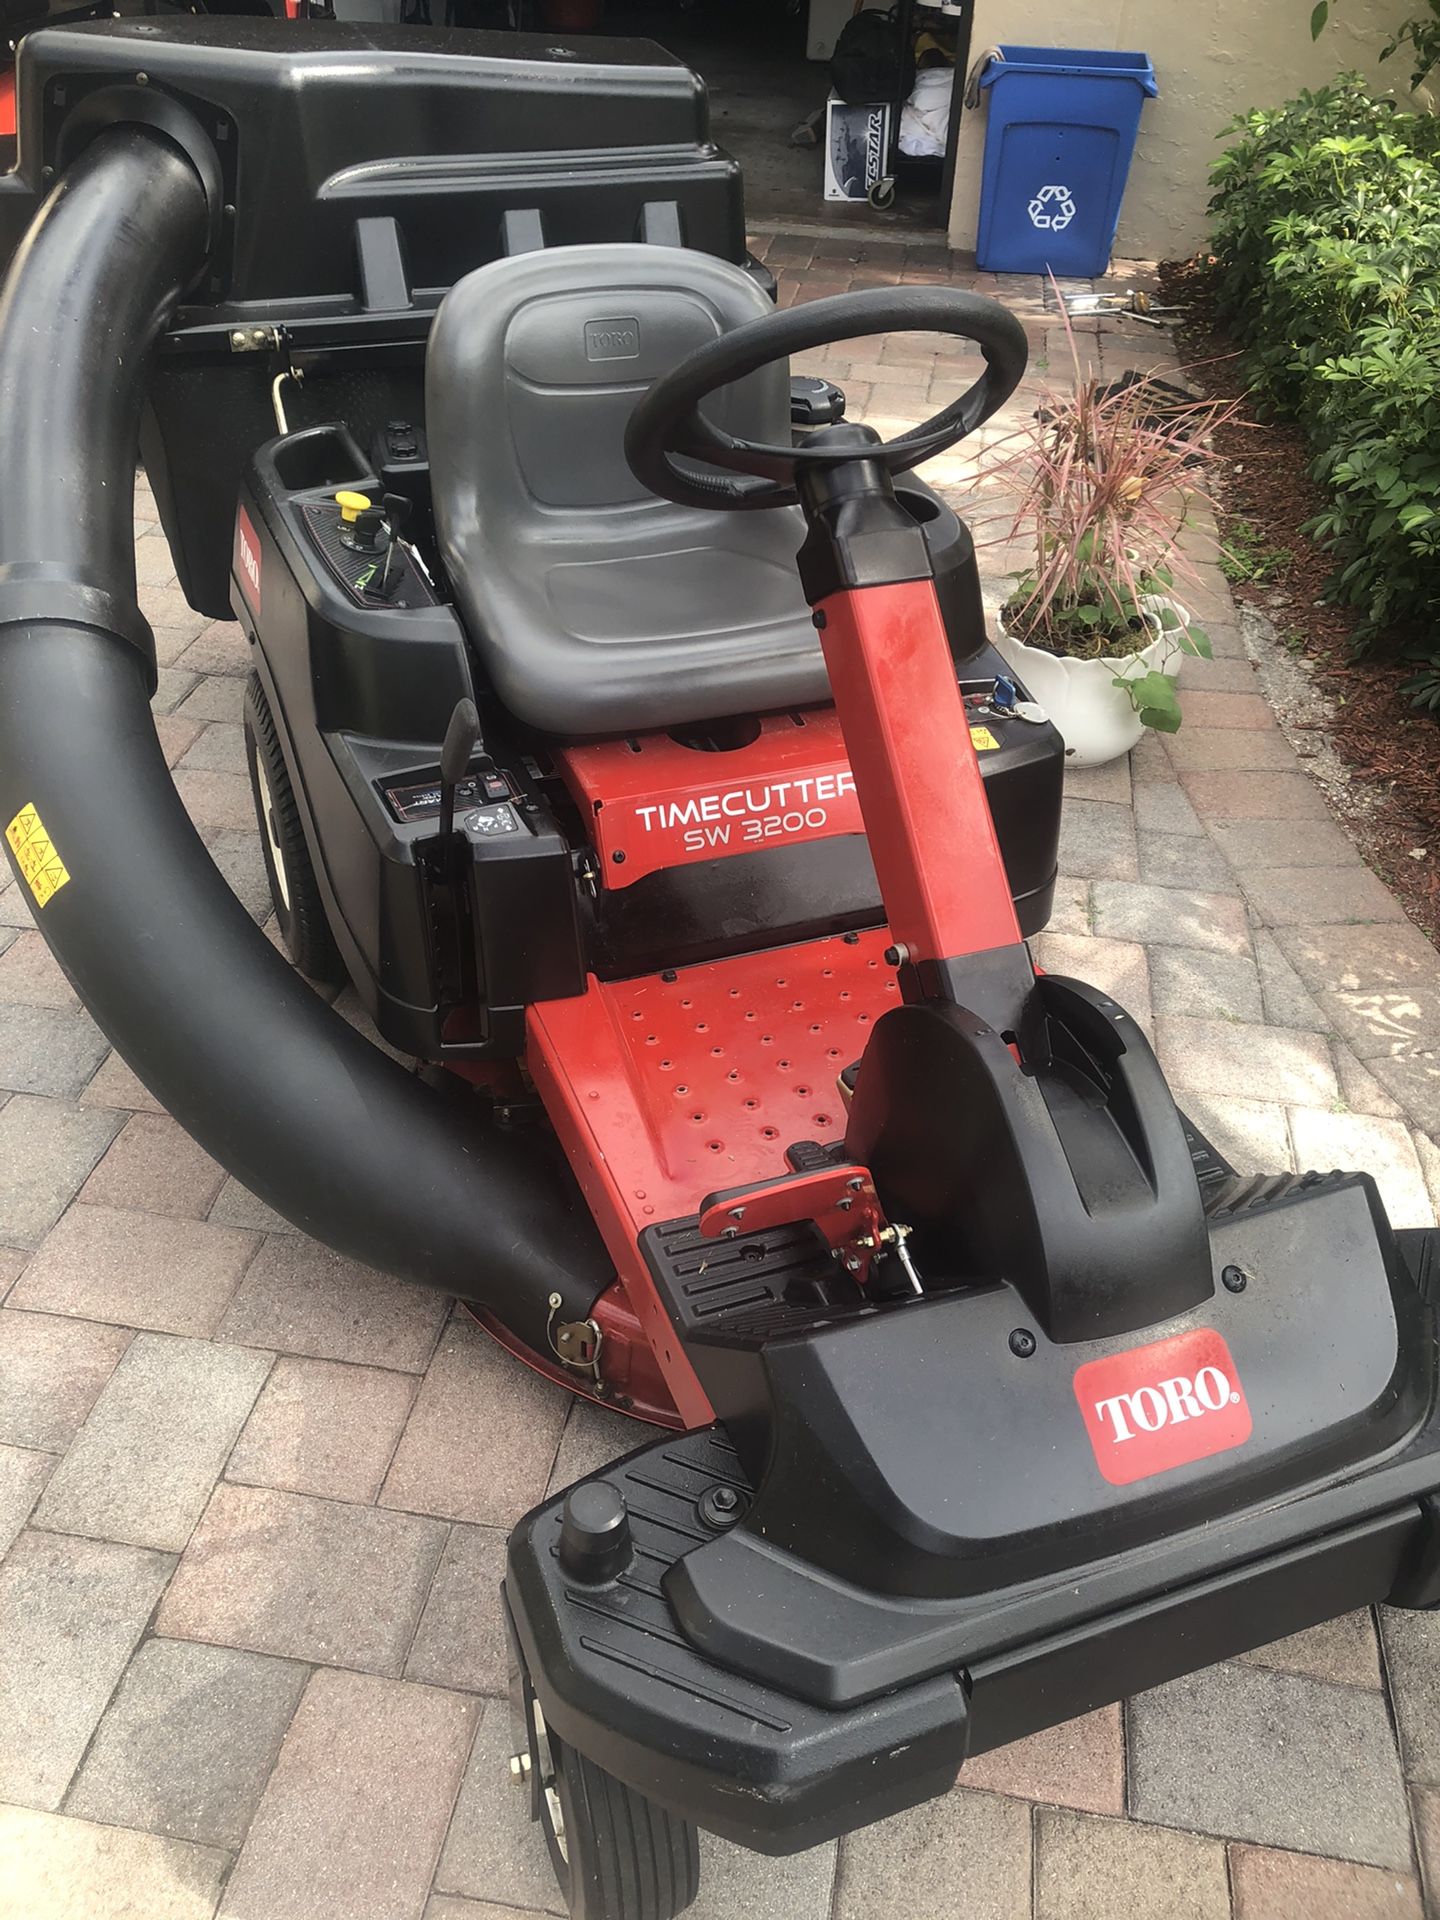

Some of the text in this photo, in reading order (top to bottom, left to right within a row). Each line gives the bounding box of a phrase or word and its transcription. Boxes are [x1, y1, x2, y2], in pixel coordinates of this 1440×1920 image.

[589, 329, 635, 348] TORO
[240, 528, 260, 591] TORO
[683, 807, 828, 852] SW 3200
